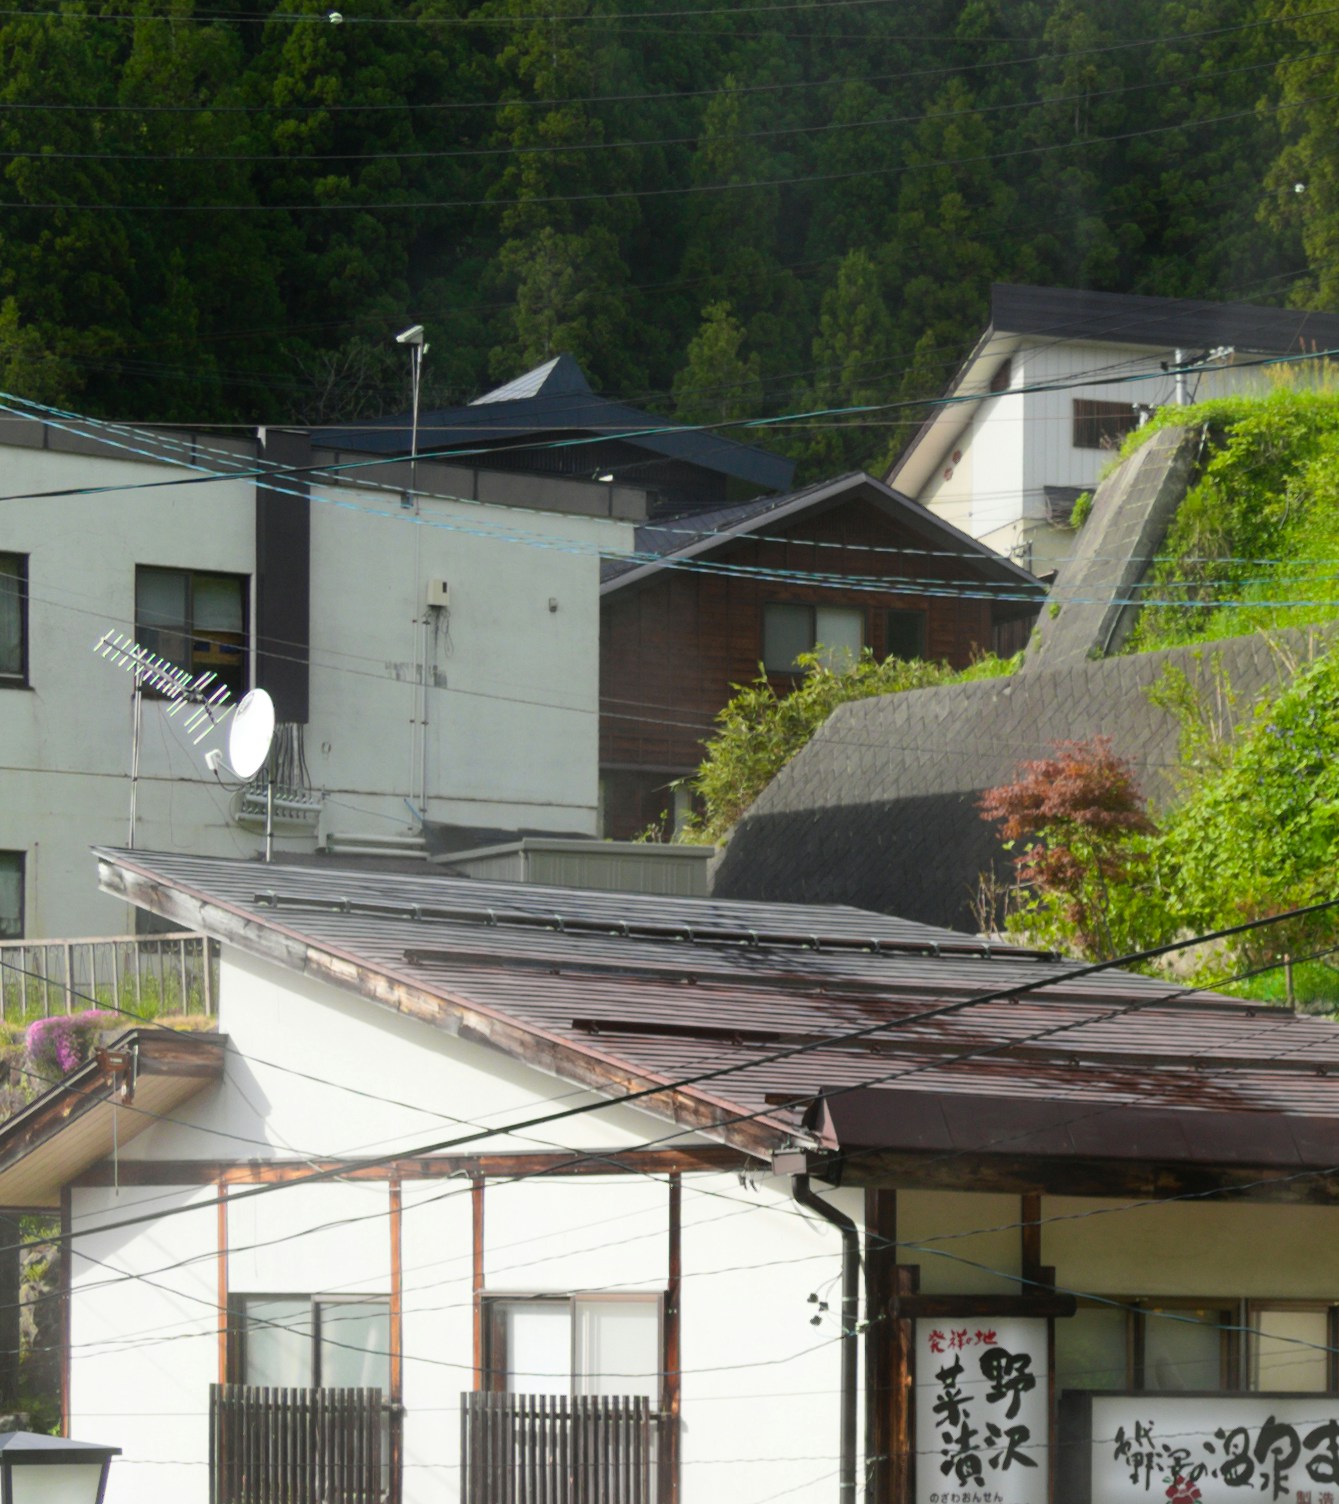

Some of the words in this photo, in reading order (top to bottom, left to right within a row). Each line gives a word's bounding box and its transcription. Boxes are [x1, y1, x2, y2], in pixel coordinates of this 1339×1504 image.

[929, 1492, 1004, 1504] のざわおんせん
